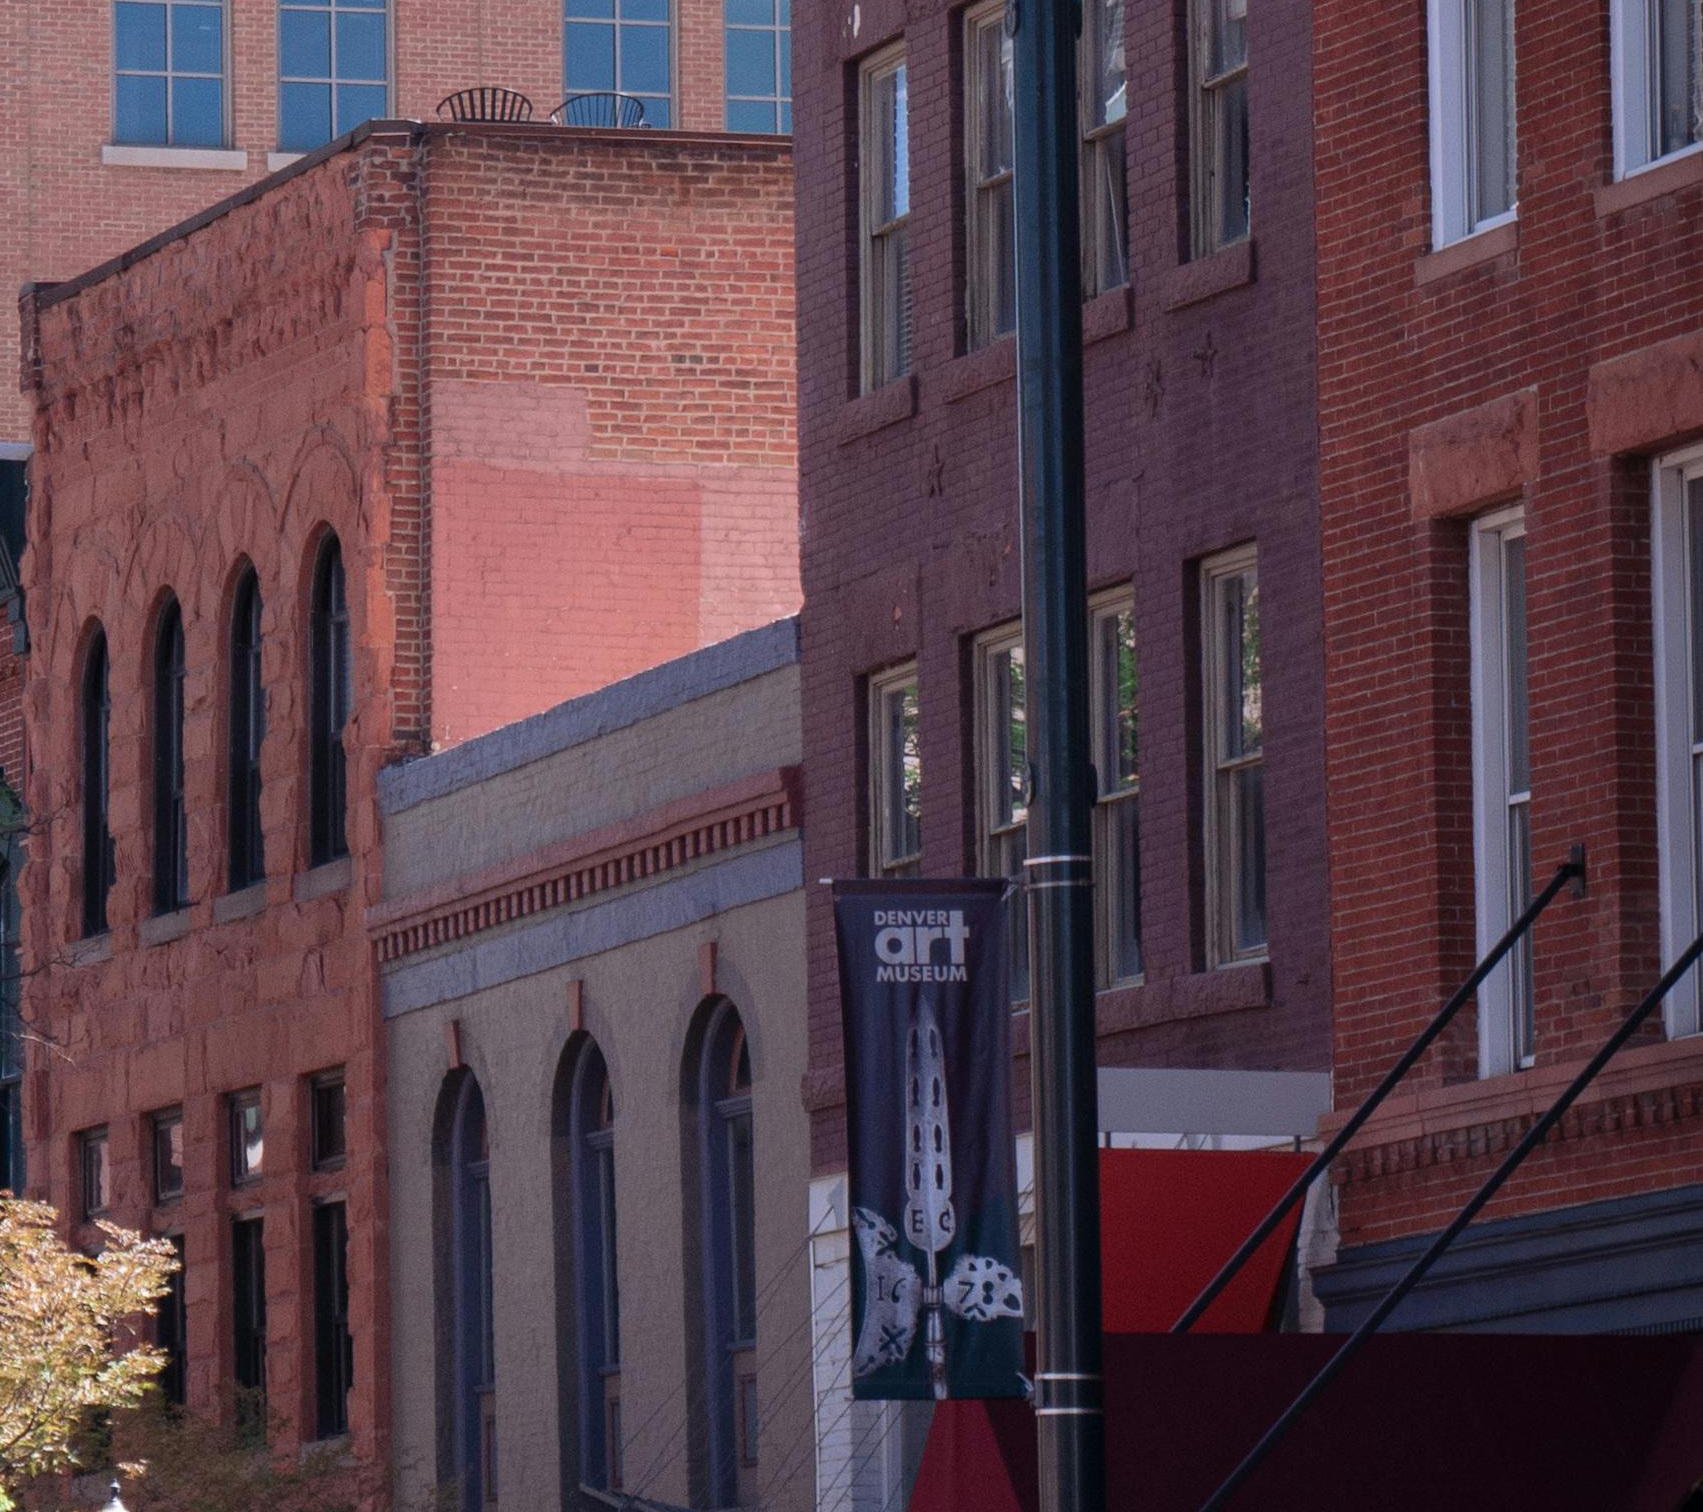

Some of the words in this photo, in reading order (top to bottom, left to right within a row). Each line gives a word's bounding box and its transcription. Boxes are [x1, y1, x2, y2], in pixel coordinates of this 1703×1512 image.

[874, 910, 948, 926] DENVER
[874, 910, 969, 965] art
[877, 966, 968, 982] MUSEUM
